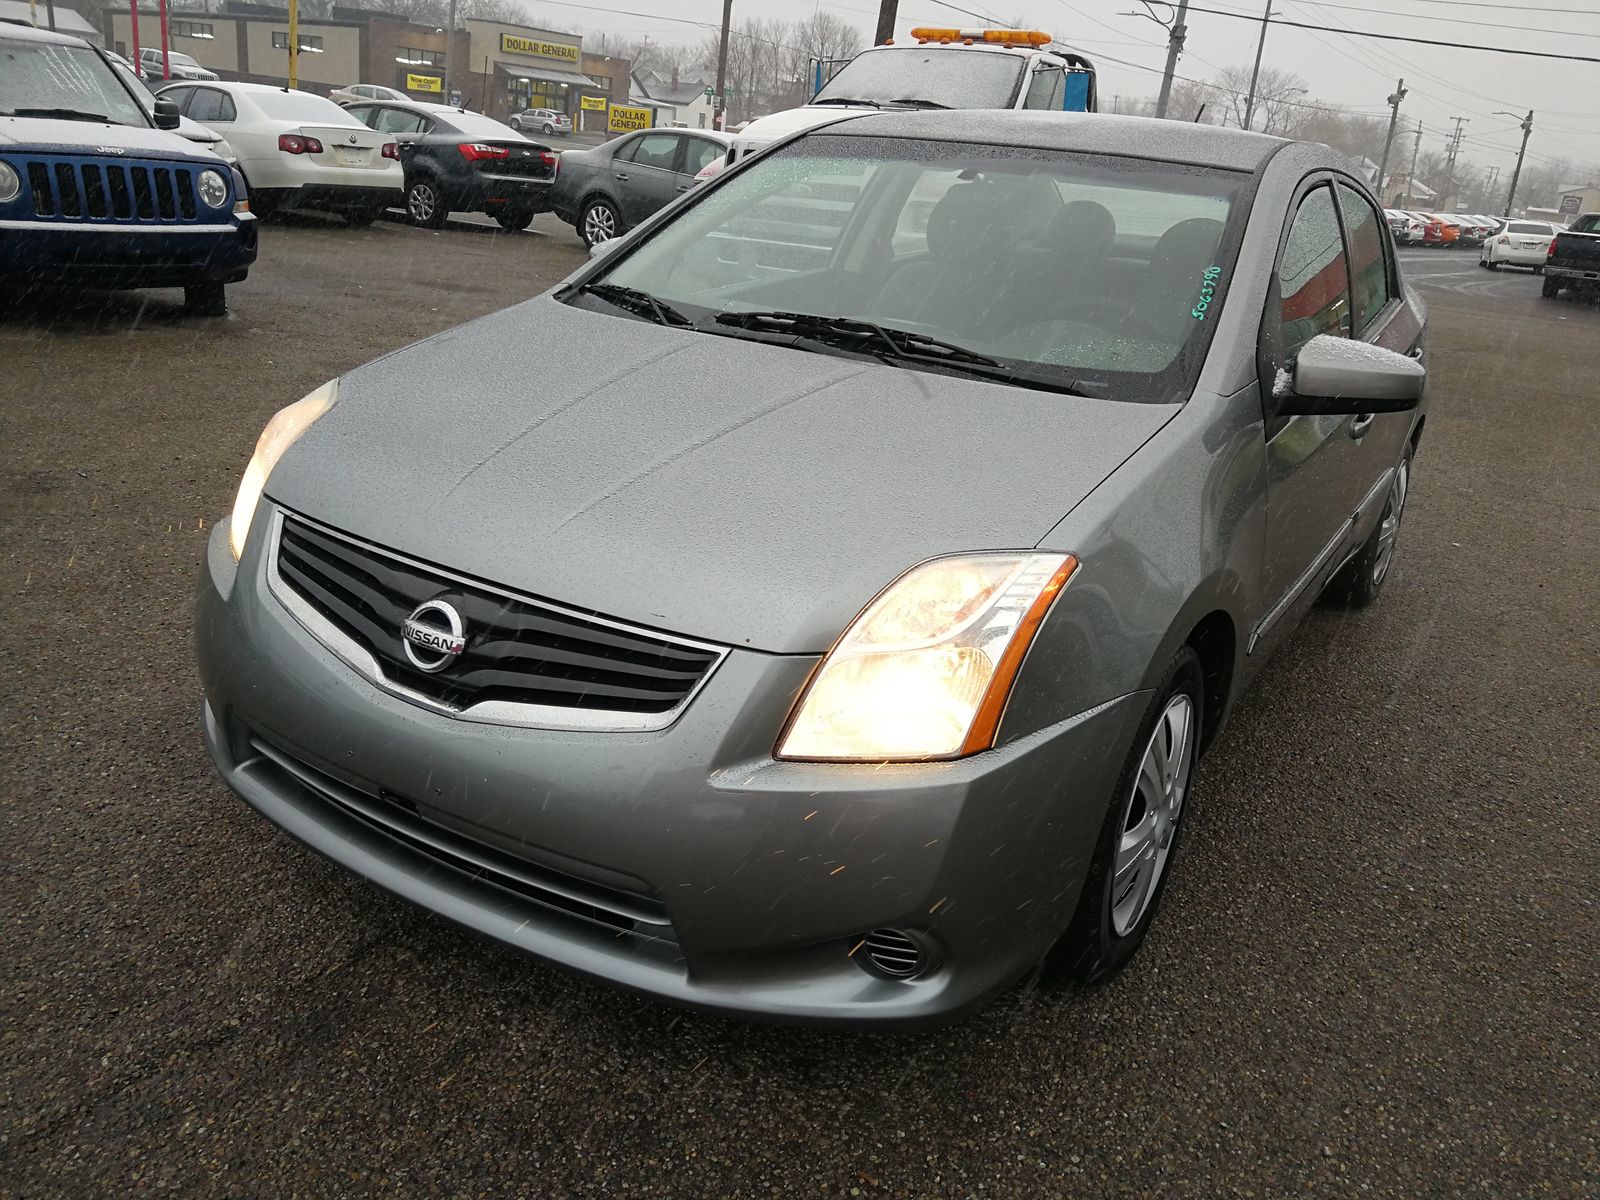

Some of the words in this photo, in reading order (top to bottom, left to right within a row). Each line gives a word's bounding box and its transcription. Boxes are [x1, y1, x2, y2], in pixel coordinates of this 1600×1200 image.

[506, 38, 539, 53] DOLLAR
[541, 44, 577, 59] GENERAL
[613, 109, 646, 122] DOLLAR
[96, 145, 124, 155] Jeep
[403, 623, 453, 651] NISSAN
